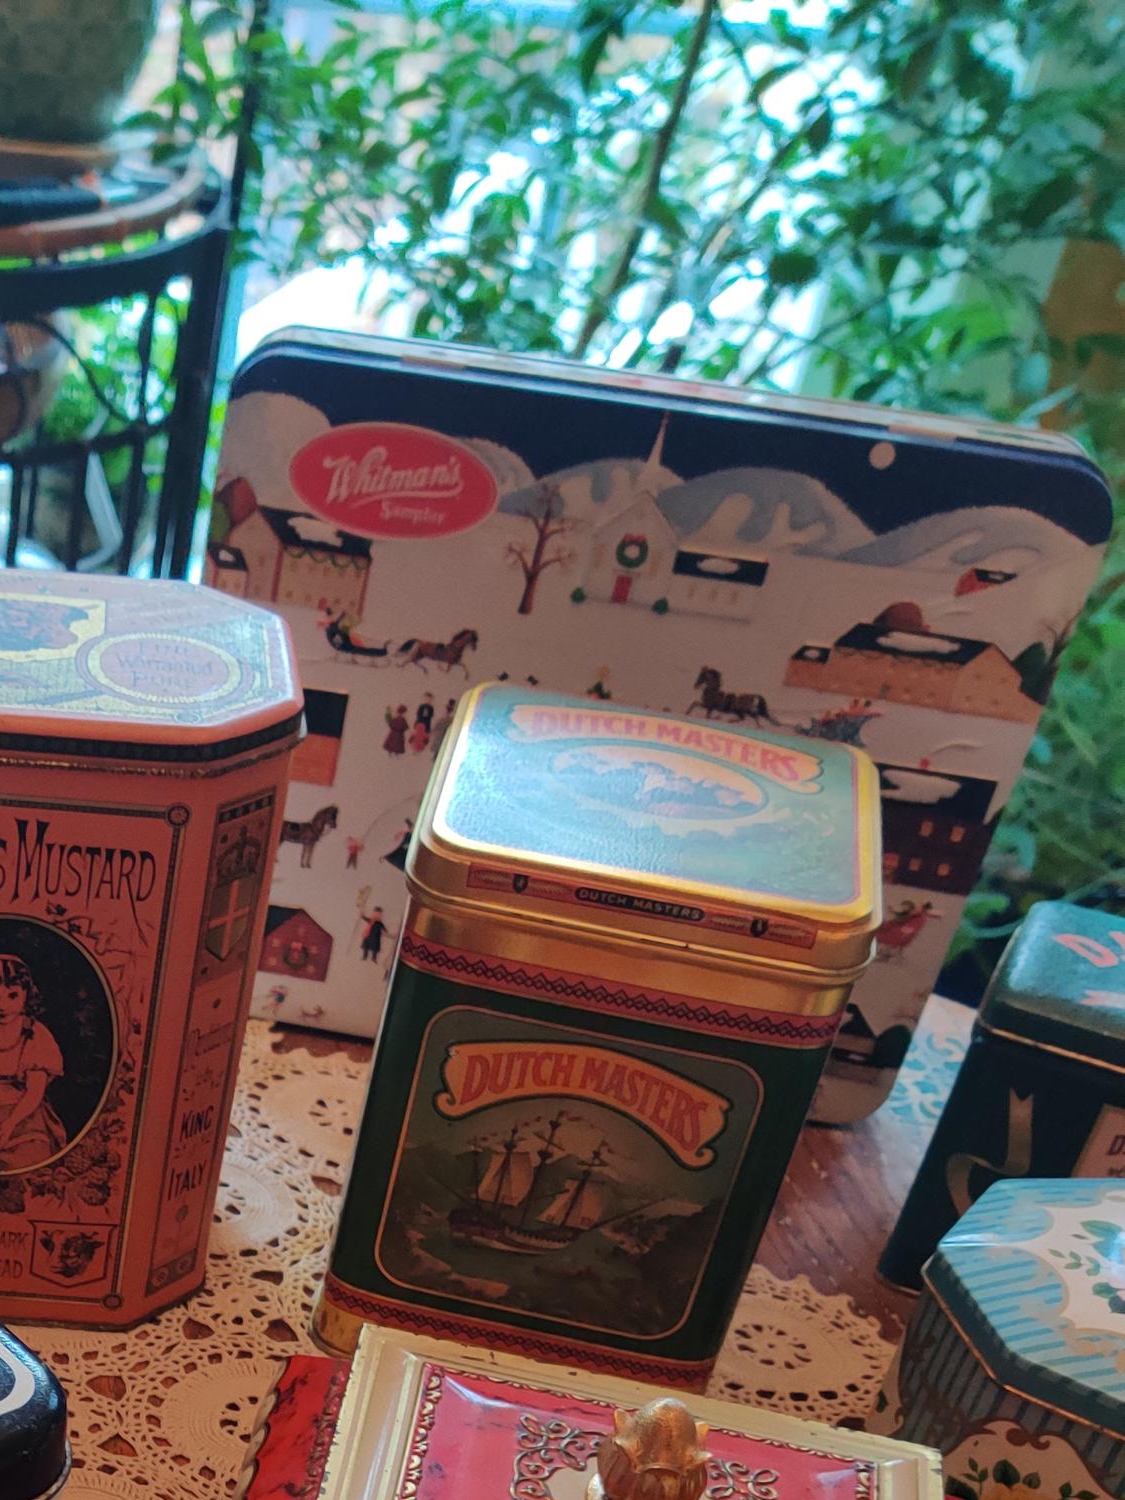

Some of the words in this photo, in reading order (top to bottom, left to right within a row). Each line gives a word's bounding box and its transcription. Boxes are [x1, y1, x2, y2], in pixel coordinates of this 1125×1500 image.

[322, 446, 463, 505] Whitman's
[532, 710, 647, 738] DUTCH
[655, 723, 801, 782] MASTERS
[9, 816, 156, 930] MUSTARD
[578, 888, 627, 906] DUTCH
[633, 899, 702, 919] MASTERS
[179, 1105, 215, 1142] KING
[460, 1052, 578, 1105] DUTCH
[579, 1057, 709, 1151] MASTERS
[167, 1160, 207, 1201] ITALY
